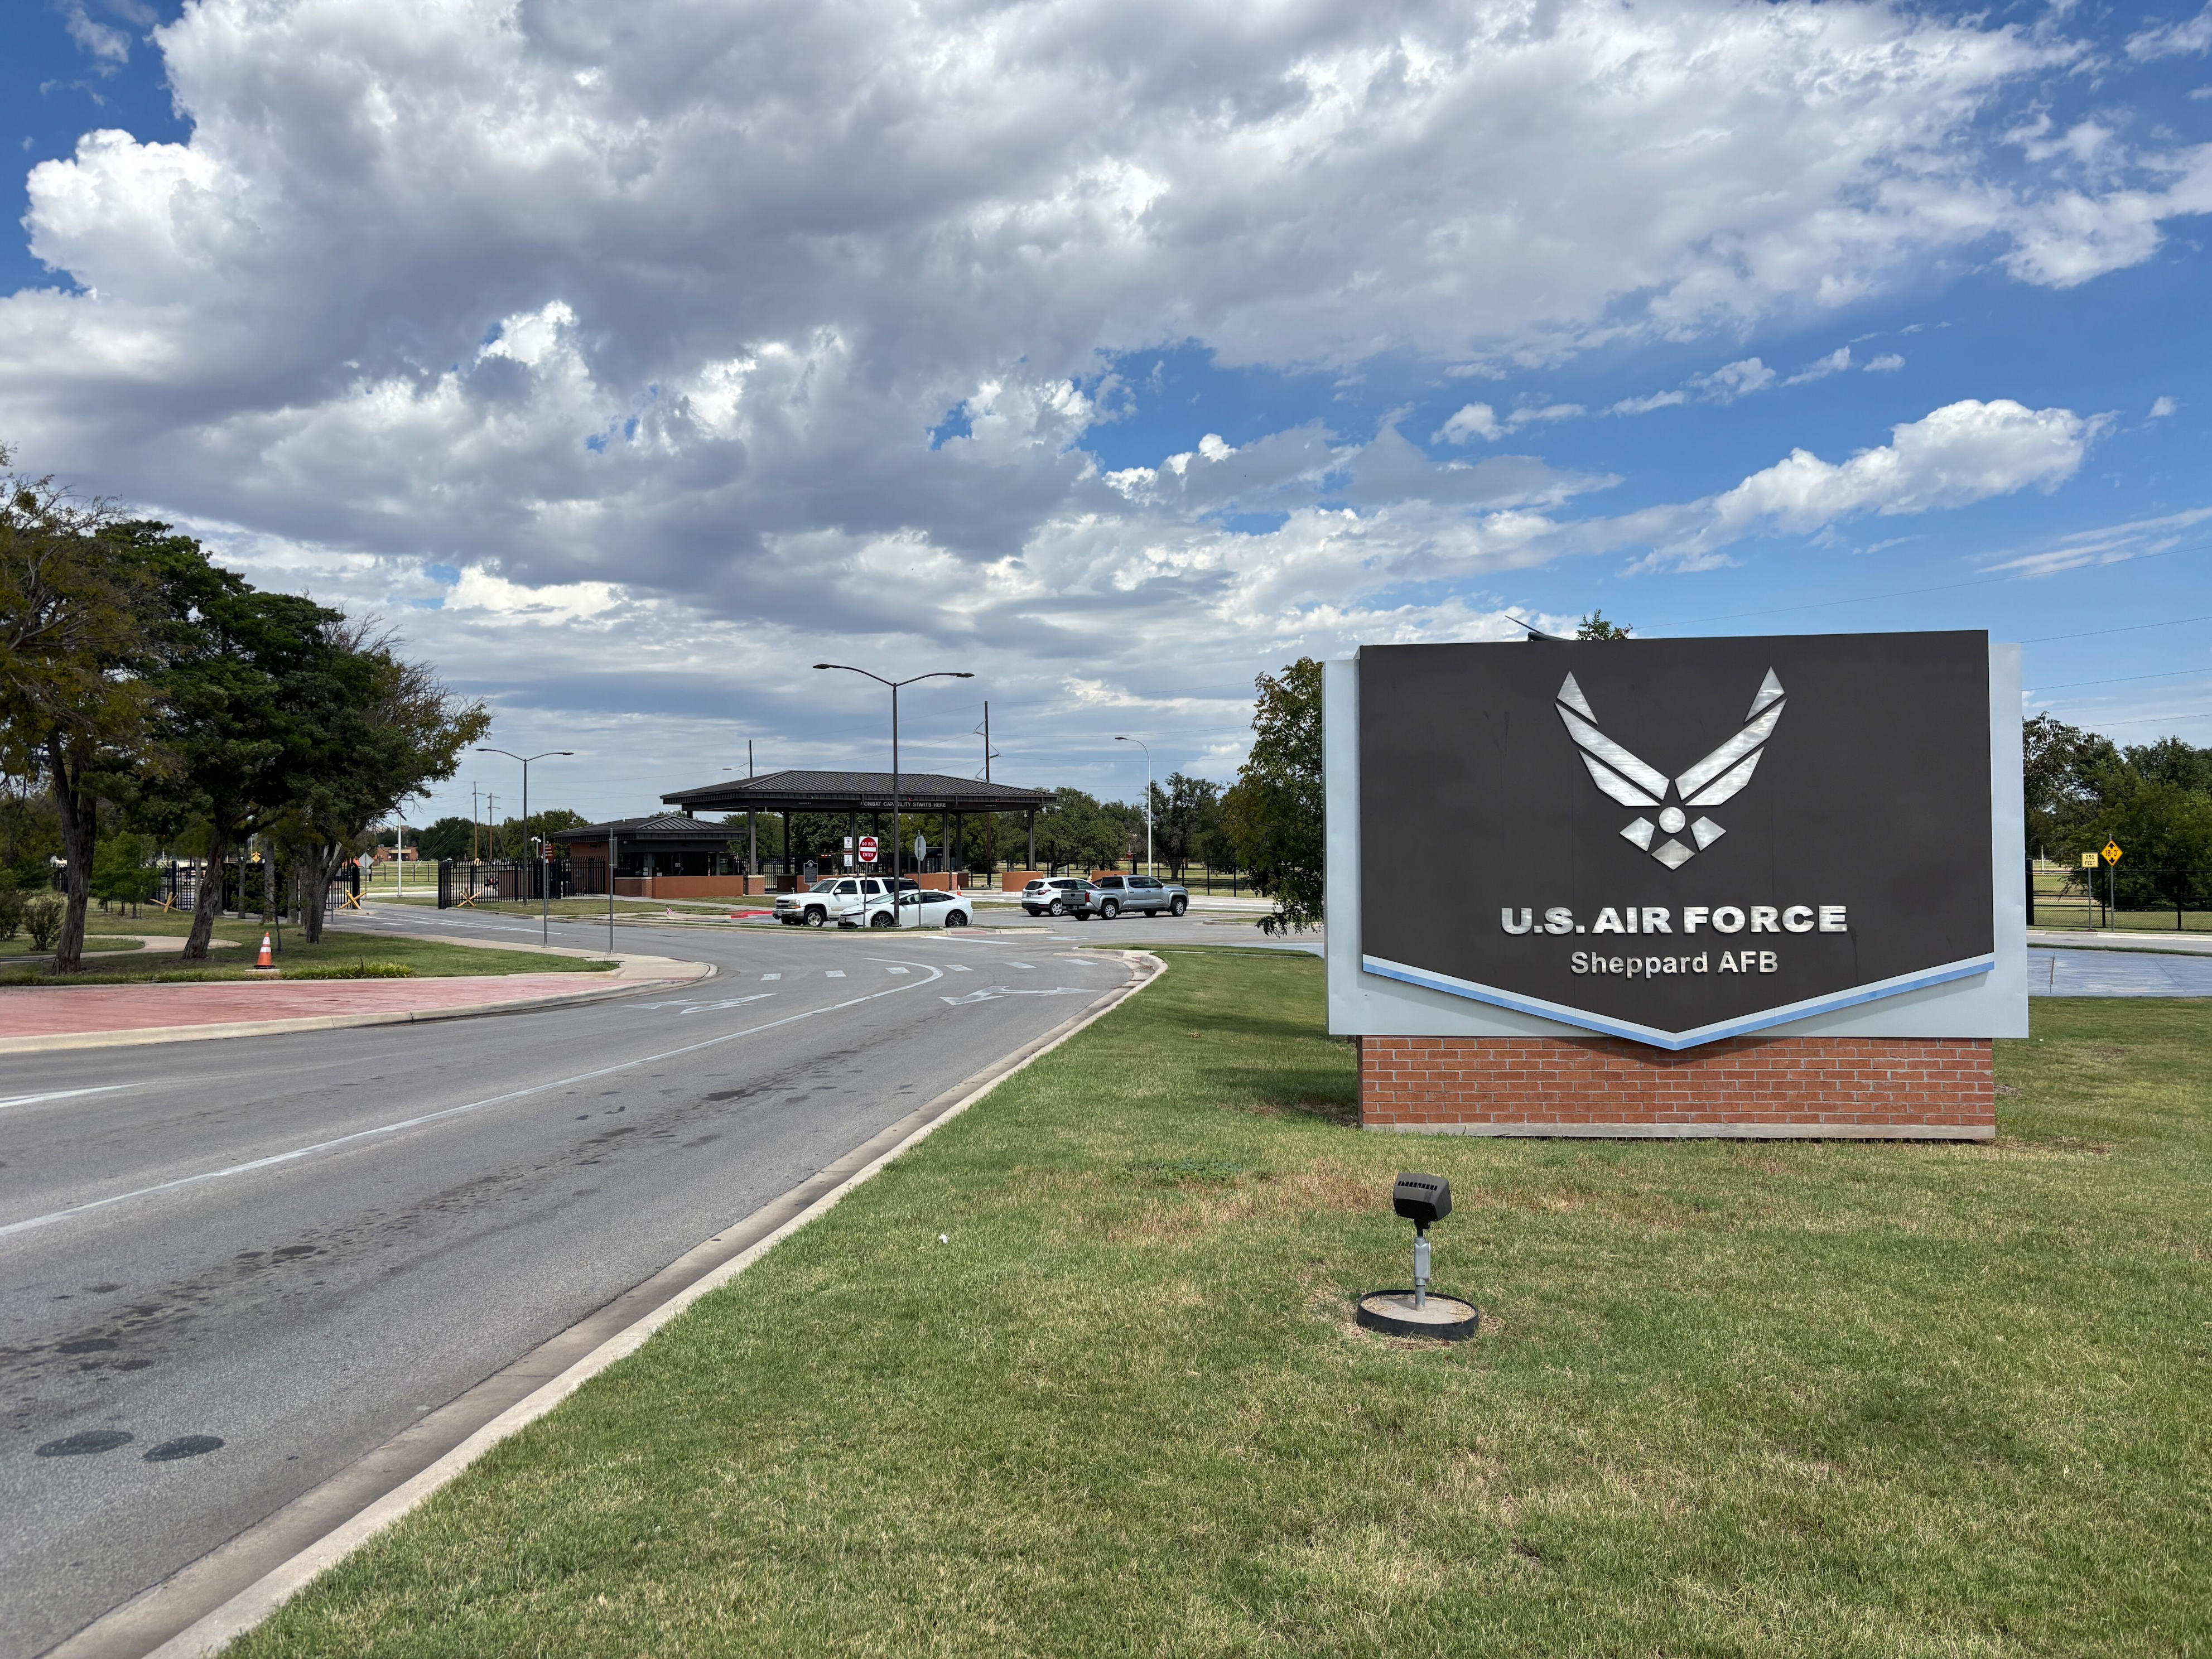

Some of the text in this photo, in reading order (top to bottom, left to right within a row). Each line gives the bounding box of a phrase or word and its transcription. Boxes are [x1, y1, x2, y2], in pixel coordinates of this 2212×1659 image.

[1501, 905, 1848, 935] U.S. AIR FORCE
[1570, 951, 1779, 978] Sheppard AFB
